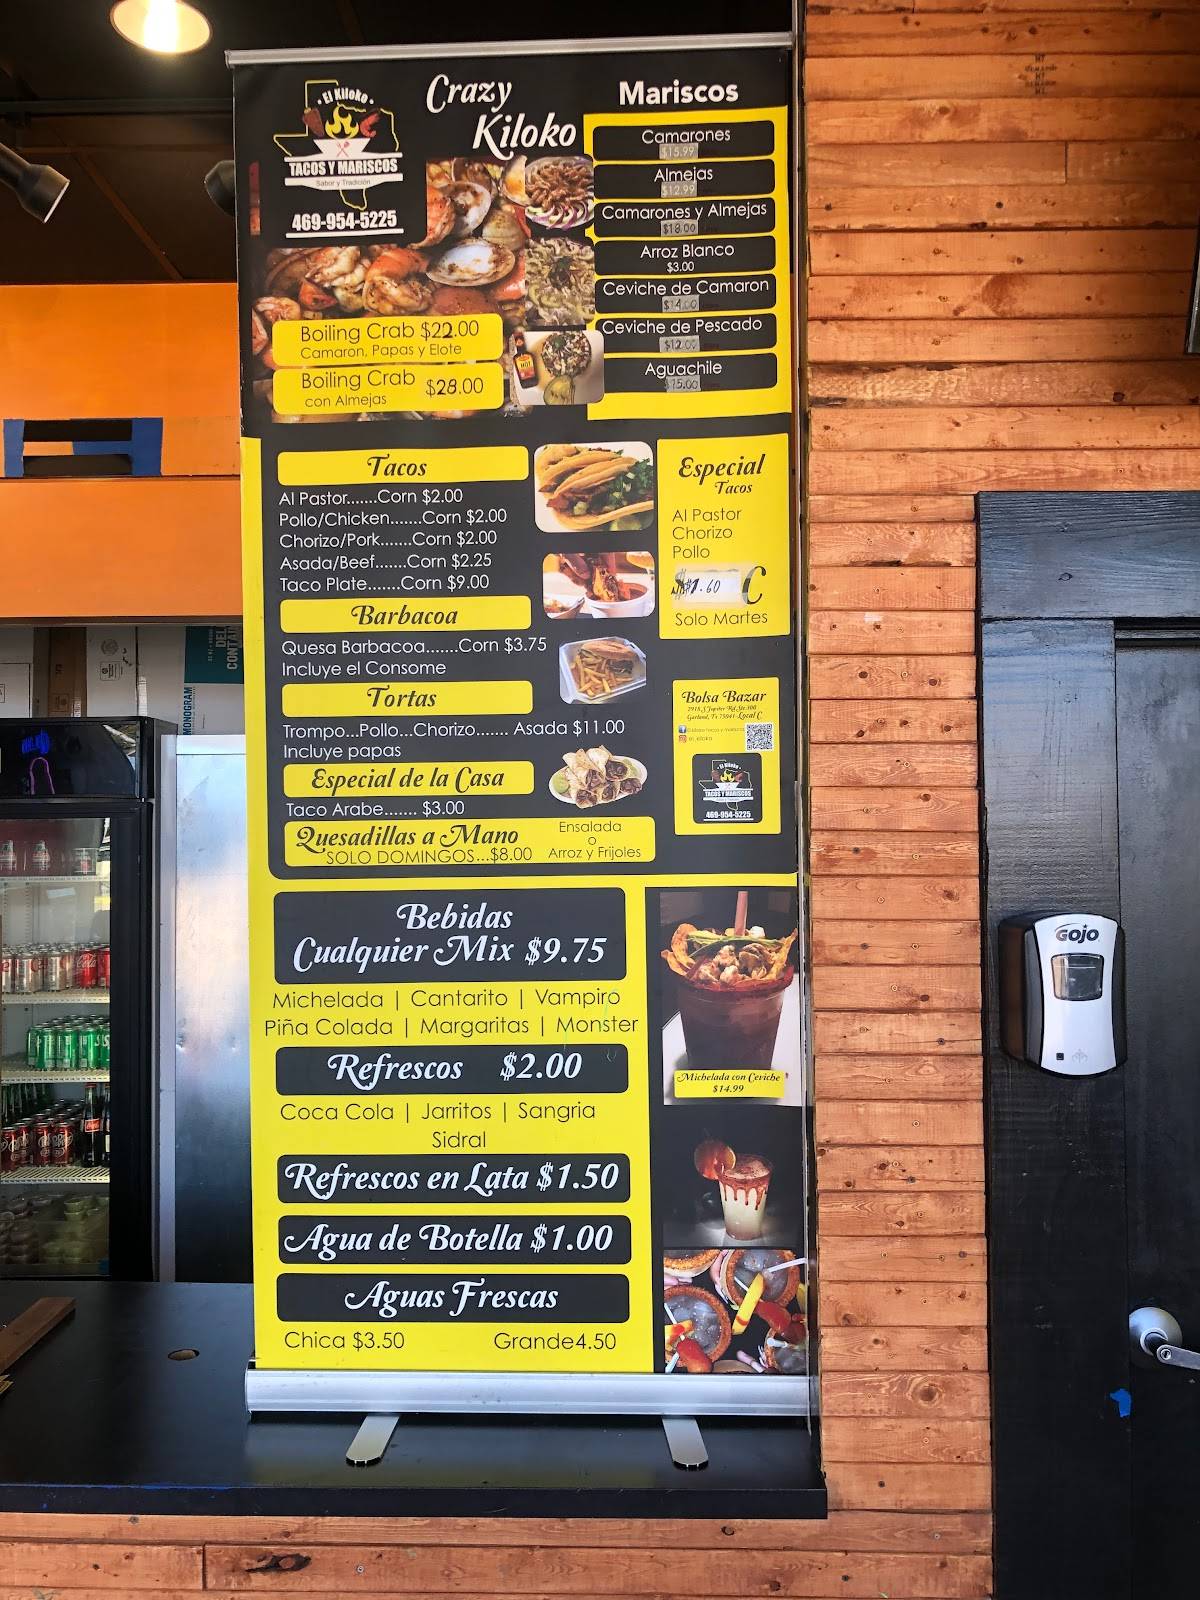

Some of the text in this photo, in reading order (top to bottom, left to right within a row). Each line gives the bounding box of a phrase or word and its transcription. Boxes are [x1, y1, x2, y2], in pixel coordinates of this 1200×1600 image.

[322, 87, 369, 104] El Kiloko
[426, 74, 512, 113] Crazy
[619, 79, 739, 105] Mariscos
[472, 112, 577, 160] Kiloko
[641, 128, 731, 144] Camarones
[661, 146, 695, 158] $15.99
[289, 158, 398, 176] TACOS Y MARISCOS
[654, 166, 713, 182] Almejas
[660, 184, 695, 196] $12.99
[602, 202, 767, 220] Camarones y Almejas
[292, 210, 398, 231] 469-954-5225
[640, 244, 735, 259] Arroz Blanco
[666, 262, 695, 274] $3.00
[602, 279, 769, 296] Ceviche de Camaron
[300, 320, 480, 344] Boiling Crab $22.00
[602, 317, 762, 335] Ceviche de Pescado
[300, 343, 462, 361] Camaron, Papas y Elote
[644, 360, 723, 379] Aguachile
[301, 368, 484, 397] Boiling Crab $28.00
[304, 392, 387, 408] con Almejas
[367, 454, 428, 477] Tacos
[678, 454, 767, 486] Especial
[278, 492, 296, 506] Al
[422, 488, 464, 505] $2.00
[714, 480, 753, 496] Tacos
[466, 508, 507, 525] $2.00
[672, 508, 742, 523] Al Pastor
[456, 530, 498, 548] $2.00
[672, 525, 733, 540] Chorizo
[450, 552, 492, 570] $2.25
[672, 544, 710, 560] Pollo
[280, 577, 322, 592] Taco
[446, 574, 490, 592] $9.00
[351, 604, 458, 626] Barbacoa
[674, 610, 768, 627] Solo Martes
[282, 640, 337, 656] Quesa
[504, 637, 547, 654] $3.75
[282, 660, 446, 678] Incluye el Consome
[367, 684, 437, 708] Tortas
[682, 690, 766, 704] Bolsa Bazar
[182, 687, 192, 735] MONOGRAM
[514, 720, 568, 736] Asada
[572, 719, 626, 737] $11.00
[284, 744, 402, 762] Incluye papas
[311, 767, 506, 796] Especial de la Casa
[286, 804, 328, 818] Taco
[422, 800, 465, 818] $3.00
[706, 810, 751, 818] 469-954-5225
[559, 820, 622, 834] Ensalada
[296, 824, 519, 854] Quesadillas a Mano
[588, 836, 596, 846] o
[326, 850, 372, 865] SOLO
[548, 845, 642, 861] Arroz y Frijoles
[396, 902, 513, 931] Bebidas
[293, 935, 608, 974] Cualquier Mix $9.75
[272, 988, 622, 1012] Michelada Cantarito Vampiro
[265, 1016, 639, 1039] Piña Colada Margaritas Monster
[327, 1052, 582, 1091] Refrescos $2.00
[676, 1072, 730, 1083] Michelada
[748, 1072, 780, 1084] Ceviche
[712, 1084, 744, 1094] $14.99
[280, 1100, 596, 1123] Coca Cola Jarritos Sangria
[432, 1130, 487, 1149] Sidral
[284, 1160, 620, 1200] Refrescos en Lata $1.50
[284, 1222, 614, 1261] Agua de Botella $1.00
[344, 1278, 559, 1318] Aguas Frescas
[284, 1330, 346, 1350] Chica
[352, 1330, 405, 1353] $3.50
